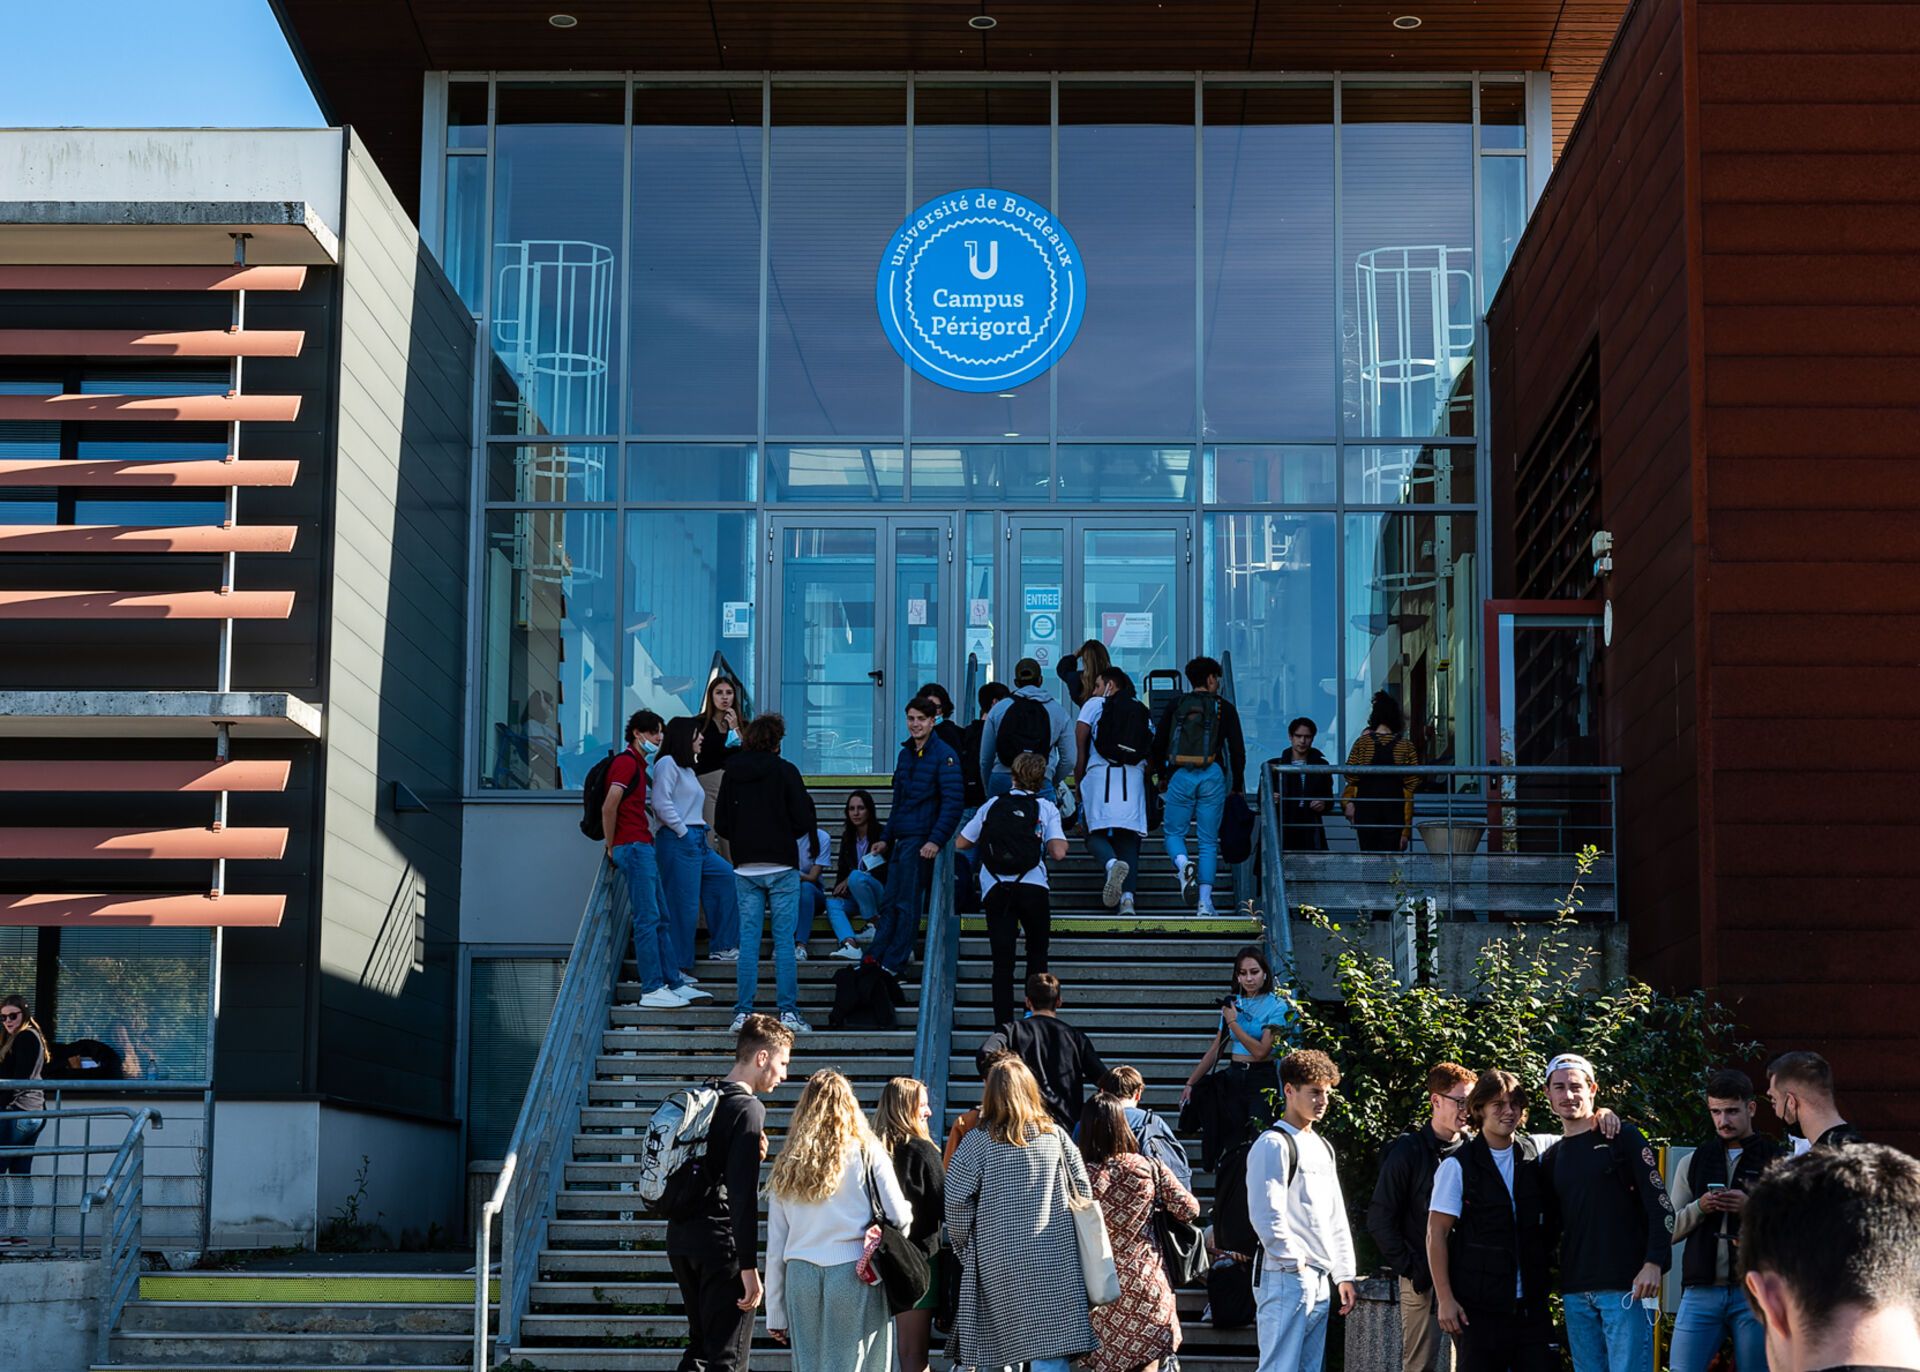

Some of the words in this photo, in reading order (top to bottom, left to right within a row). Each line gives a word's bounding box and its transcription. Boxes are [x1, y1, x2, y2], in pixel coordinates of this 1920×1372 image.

[891, 195, 969, 266] université
[975, 193, 997, 209] de
[1002, 197, 1073, 267] Bordeaux
[932, 288, 1025, 313] Campus
[931, 315, 1032, 341] Périgord
[1026, 593, 1059, 606] ENTREE
